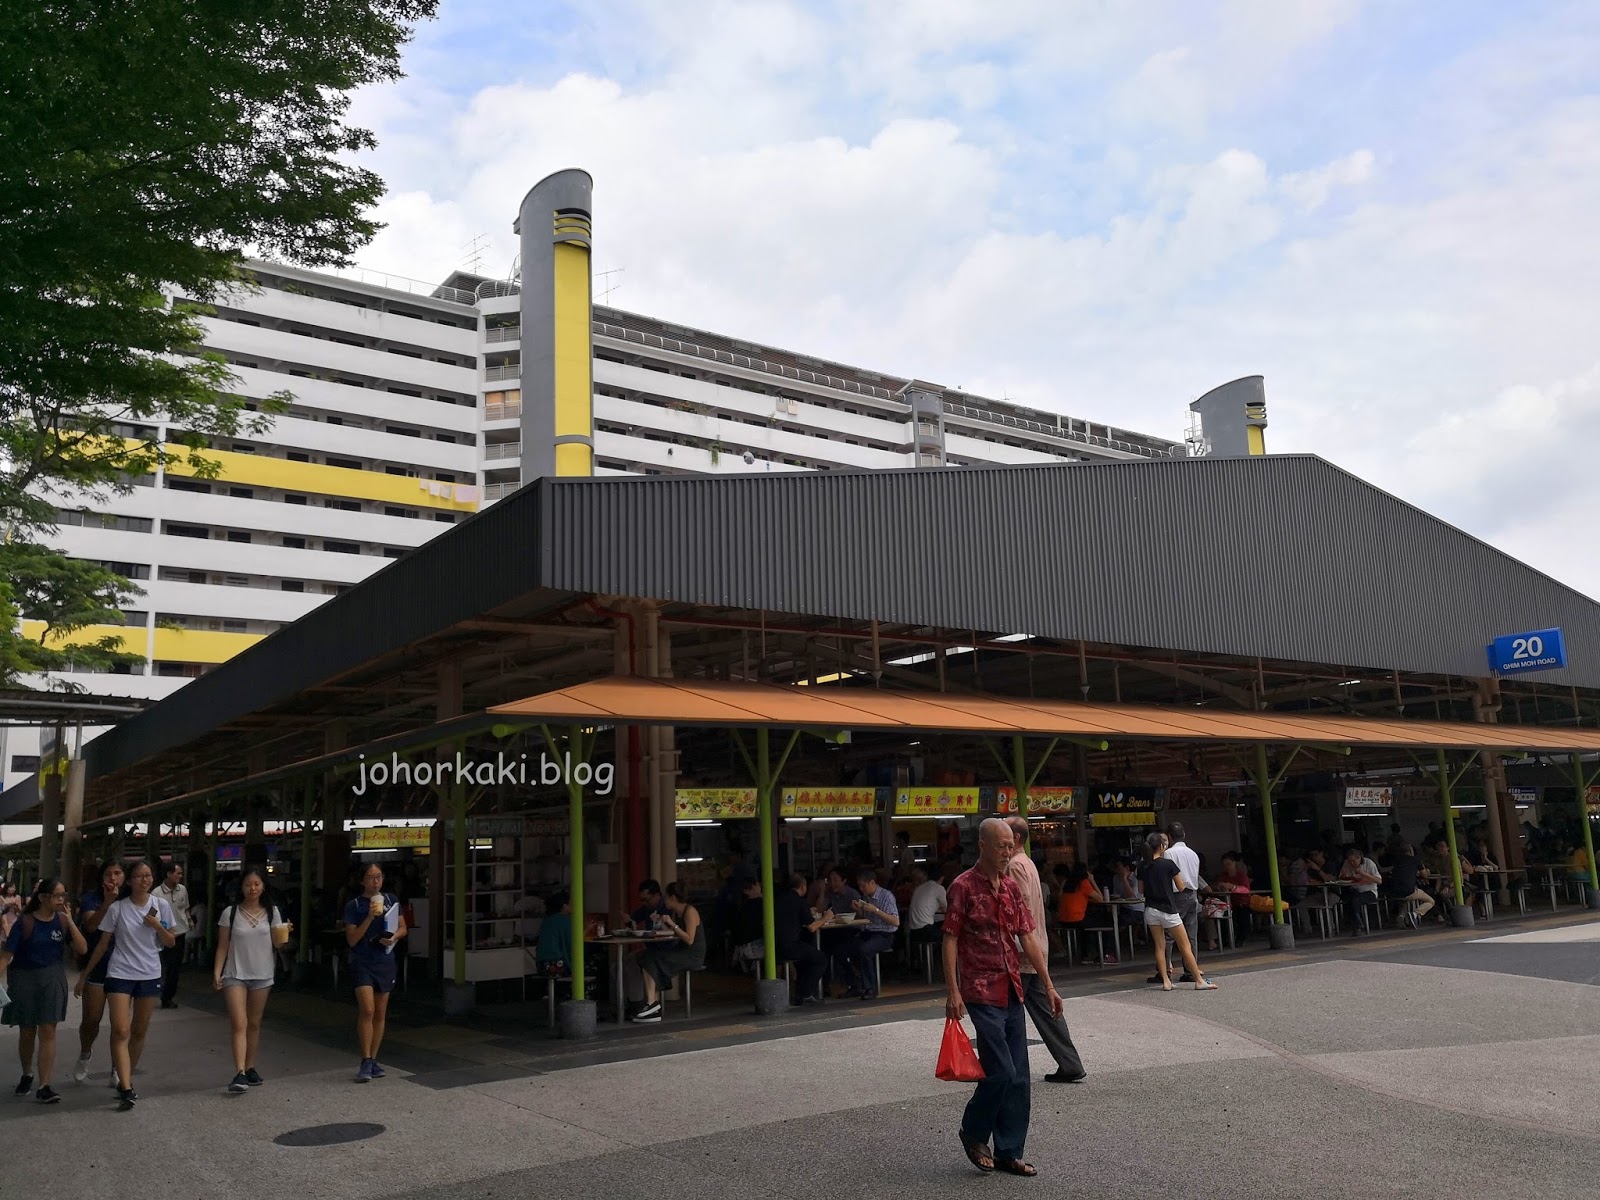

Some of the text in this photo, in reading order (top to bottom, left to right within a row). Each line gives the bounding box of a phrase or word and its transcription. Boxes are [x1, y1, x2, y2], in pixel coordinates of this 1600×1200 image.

[1512, 636, 1543, 660] 20
[1503, 657, 1556, 670] GHIM MOH ROAD
